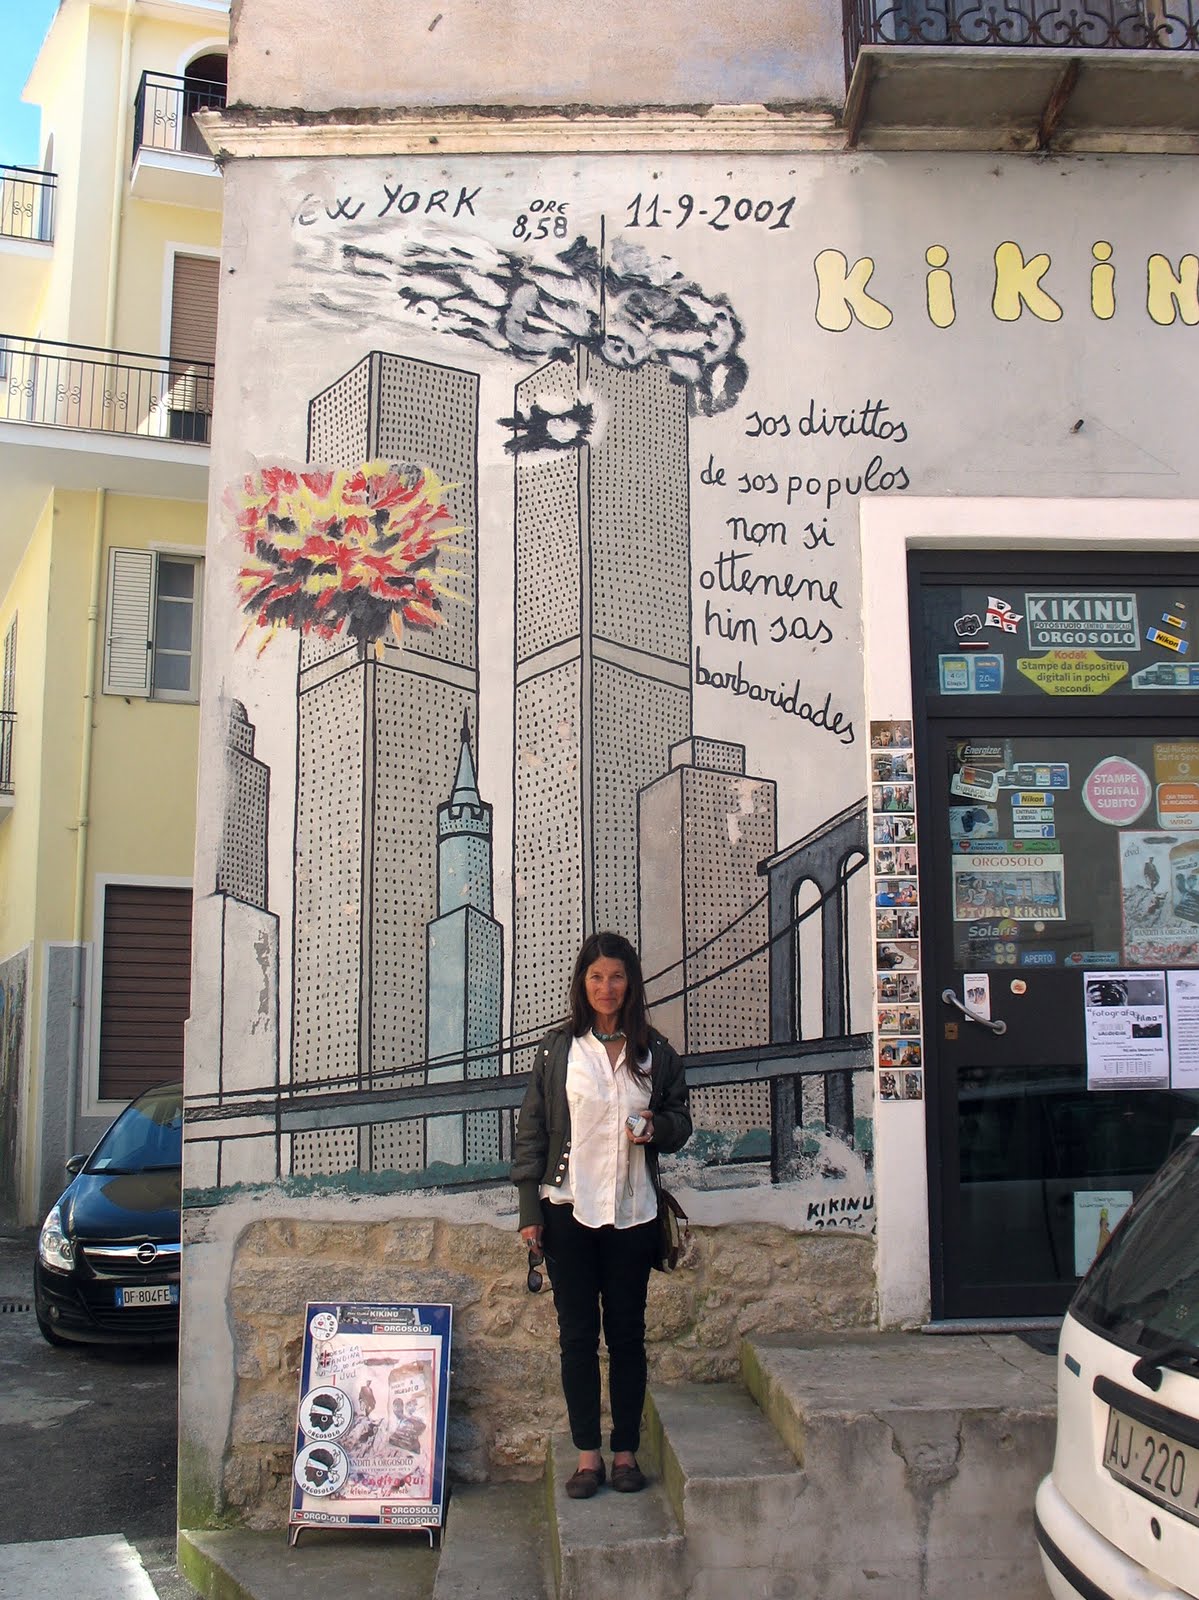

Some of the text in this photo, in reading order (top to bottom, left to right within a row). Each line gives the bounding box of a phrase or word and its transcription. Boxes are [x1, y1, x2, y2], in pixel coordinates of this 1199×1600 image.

[378, 183, 483, 218] YORK
[529, 199, 570, 215] ORE
[624, 192, 797, 231] 11-9-2001
[512, 214, 568, 243] 8,58
[744, 398, 908, 443] sos dirittos
[700, 453, 910, 510] de sos populos
[726, 517, 835, 549] non si
[1029, 600, 1133, 621] KIKINU
[770, 616, 833, 644] sas
[1038, 631, 1135, 644] ORGOSOLO
[1155, 633, 1179, 648] Nikon
[1054, 650, 1088, 659] Kodak
[1021, 661, 1125, 672] Stampe da dispositivi
[1036, 673, 1070, 682] digitali
[1084, 673, 1110, 682] pochi
[1054, 684, 1094, 693] secondi.
[695, 645, 855, 744] barbaridades
[964, 745, 1001, 756] Energizer
[1094, 774, 1137, 784] STAMPE
[1093, 786, 1139, 796] DIGITALI
[1021, 795, 1045, 803] Nikon
[1097, 798, 1137, 808] SUBITO
[972, 857, 1044, 867] ORGOSOLO
[968, 926, 1018, 937] Solaris
[1024, 955, 1053, 963] APERTO
[807, 1194, 874, 1221] KIKINU
[370, 1310, 399, 1318] KIKINU
[384, 1325, 430, 1333] ORGOSOLO
[307, 1429, 341, 1439] ORGOSOLO
[349, 1459, 371, 1467] ANDITI
[378, 1458, 414, 1466] ORGOSOLO
[301, 1483, 335, 1495] ORGOSOLO
[391, 1507, 438, 1515] ORGOSOLO
[391, 1516, 438, 1525] ORGOSOLO
